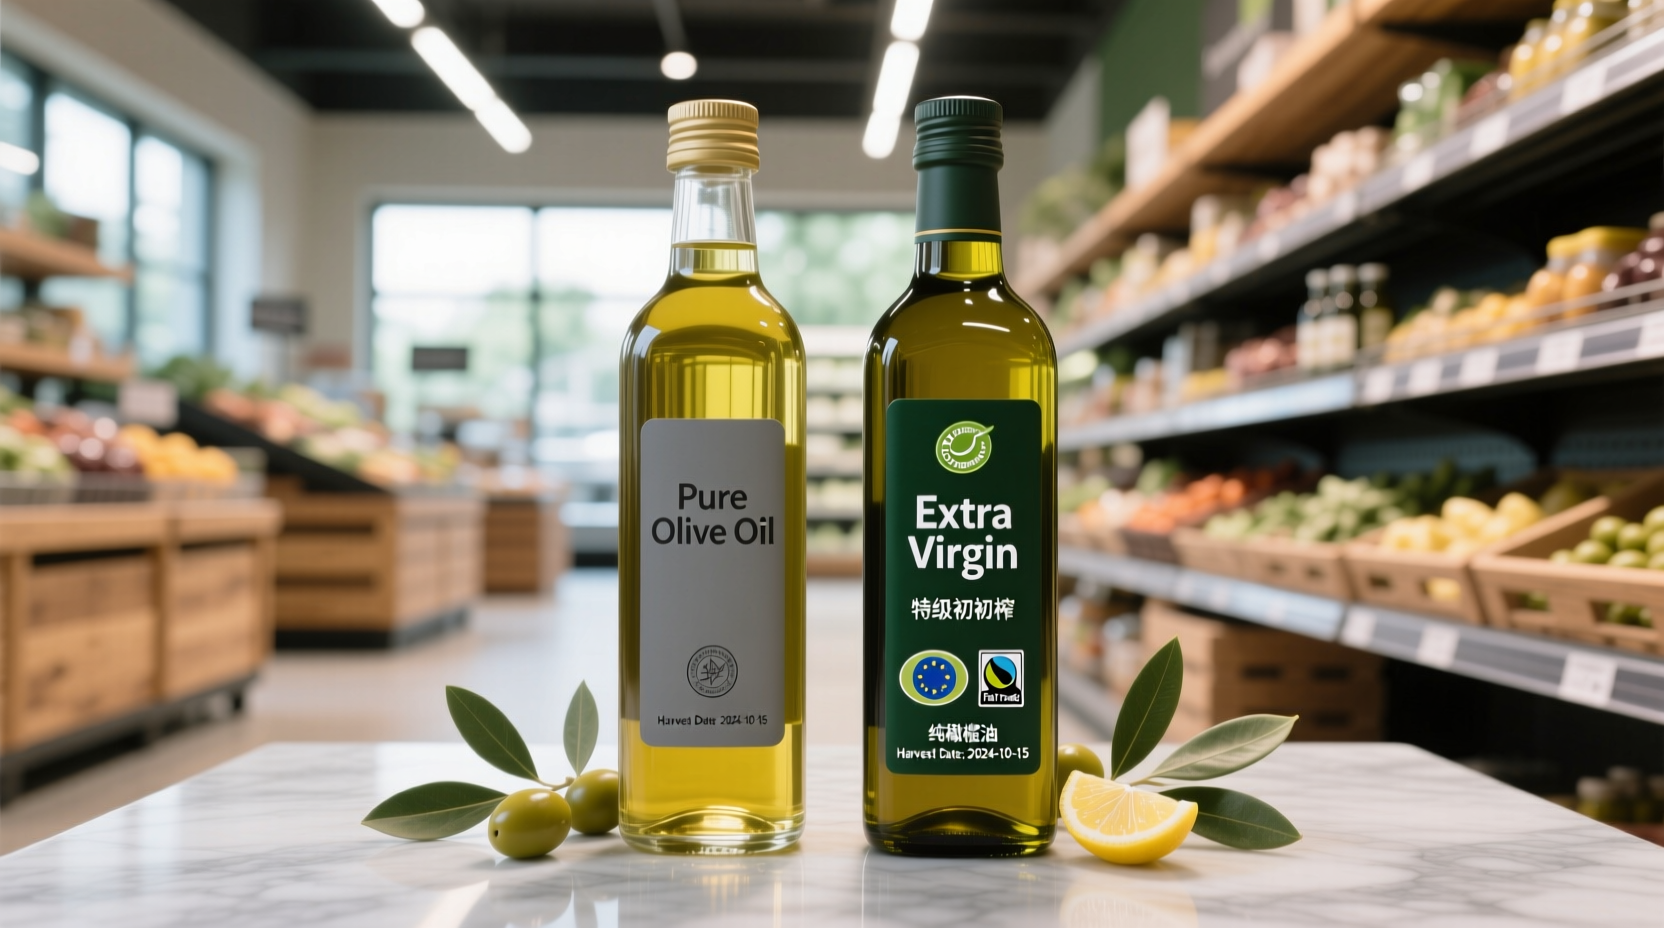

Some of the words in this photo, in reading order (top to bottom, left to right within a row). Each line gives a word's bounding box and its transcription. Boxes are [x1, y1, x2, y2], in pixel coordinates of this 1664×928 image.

[678, 482, 748, 511] Pure
[916, 494, 1012, 530] Extra
[651, 516, 727, 546] Olive
[734, 516, 775, 546] Oil
[907, 535, 1018, 580] Virgin
[911, 596, 1016, 621] 特级初初榨
[966, 746, 1031, 760] 2024-10-15
